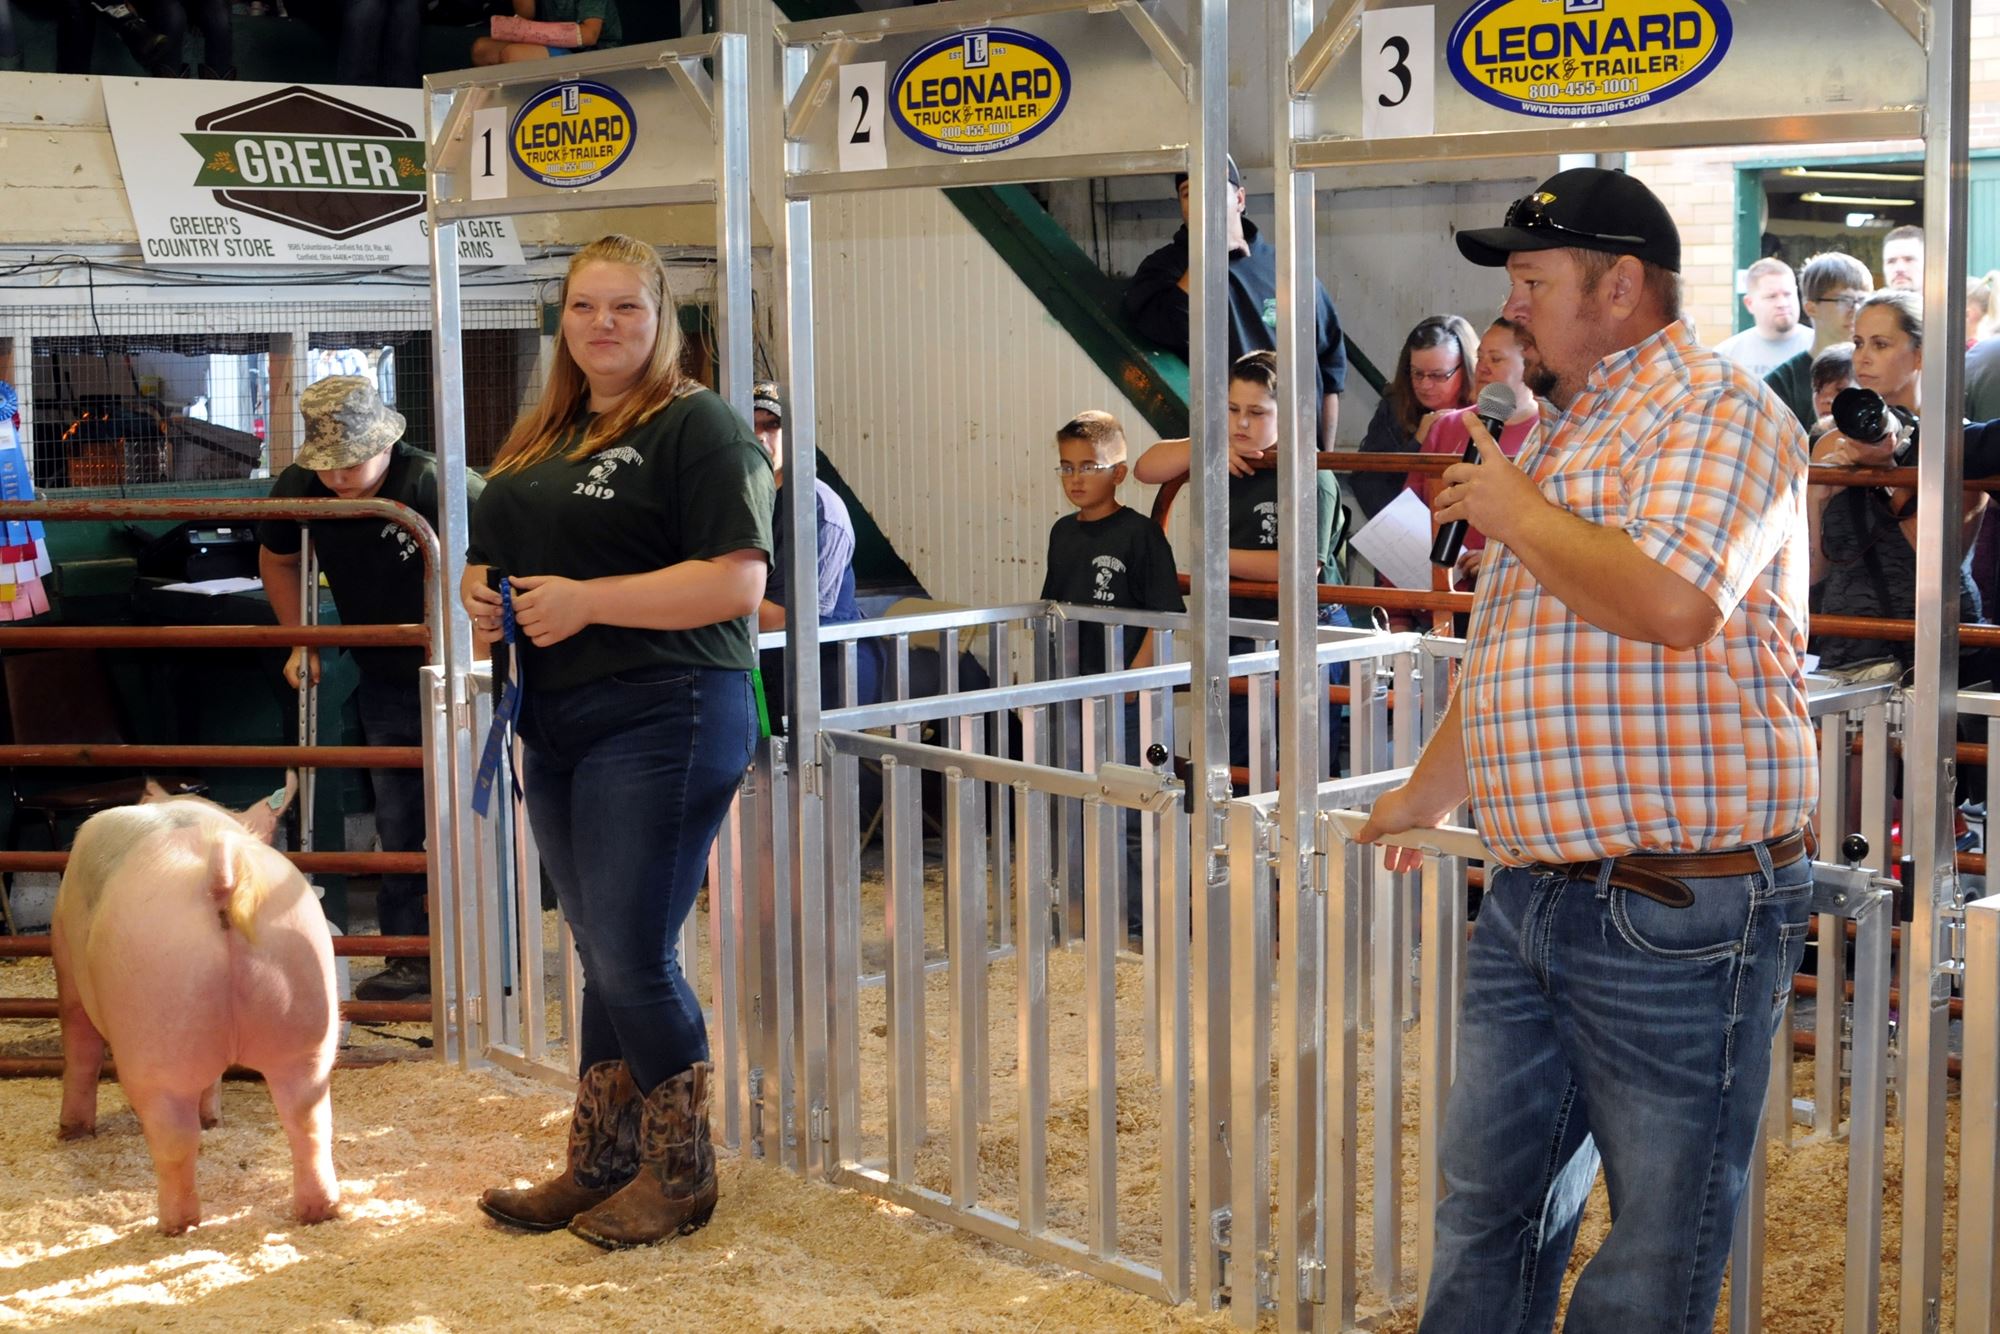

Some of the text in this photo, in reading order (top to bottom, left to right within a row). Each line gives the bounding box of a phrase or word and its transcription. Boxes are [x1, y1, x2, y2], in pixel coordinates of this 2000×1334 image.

[1474, 11, 1702, 66] LEONARD
[1377, 35, 1412, 108] 3
[1485, 60, 1560, 85] TRUCK
[1581, 55, 1679, 77] TRAILER
[906, 67, 1052, 110] LEONARD
[1528, 78, 1639, 100] 800-455-1001
[849, 85, 872, 144] 2
[913, 109, 962, 126] TRUCK
[974, 103, 1037, 122] TRAILER
[1521, 93, 1651, 116] www.leonardtrailers.com
[520, 114, 624, 151] LEONARD
[941, 121, 1012, 139] 800-455-1001
[234, 138, 400, 188] GREIER
[481, 127, 496, 178] 1
[526, 149, 561, 164] TRUCK
[569, 144, 614, 161] TRAILER
[169, 216, 242, 235] GREIER'S
[468, 220, 505, 238] GATE
[147, 238, 276, 257] COUNTRY STORE
[458, 241, 494, 258] RMS
[572, 482, 615, 500] 2019
[400, 539, 420, 562] 201
